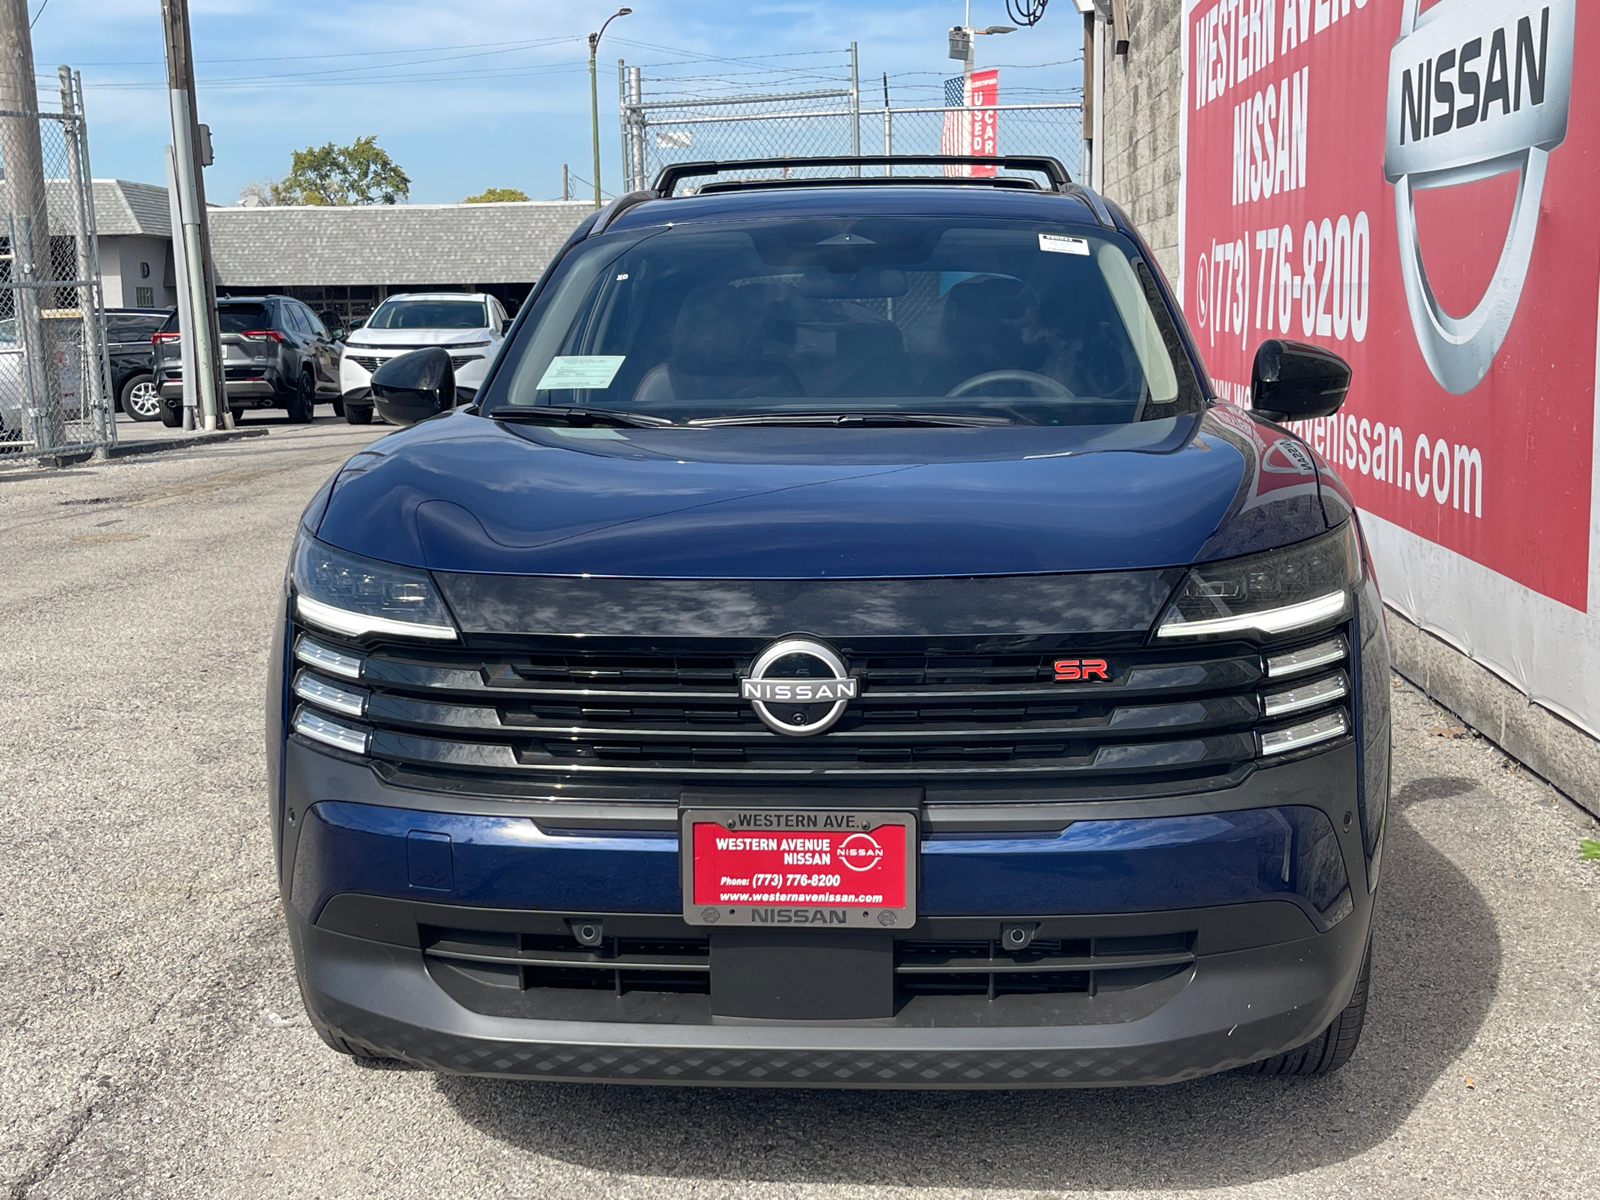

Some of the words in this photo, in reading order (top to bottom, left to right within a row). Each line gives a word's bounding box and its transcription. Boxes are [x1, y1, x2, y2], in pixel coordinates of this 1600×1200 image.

[1196, 0, 1275, 111] WESTERN
[1400, 7, 1549, 145] NISSAN
[973, 91, 983, 151] USED
[984, 110, 994, 169] CAR
[1233, 65, 1309, 206] NISSAN
[140, 262, 150, 279] D
[1209, 228, 1250, 350] (773)
[1255, 211, 1370, 342] 776-8200
[1054, 658, 1109, 681] SR
[744, 682, 855, 700] NISSAN
[738, 813, 818, 828] WESTERN
[823, 815, 860, 829] AVE.
[716, 838, 778, 851] WESTERN
[780, 838, 830, 851] AVENUE
[837, 848, 883, 856] NISSAN
[784, 853, 831, 865] NISSAN
[720, 876, 750, 887] Phone:
[752, 874, 783, 889] (773)
[786, 874, 841, 887] 776-8200
[720, 891, 883, 903] www.westernavenissan.com
[751, 908, 847, 924] NISSAN
